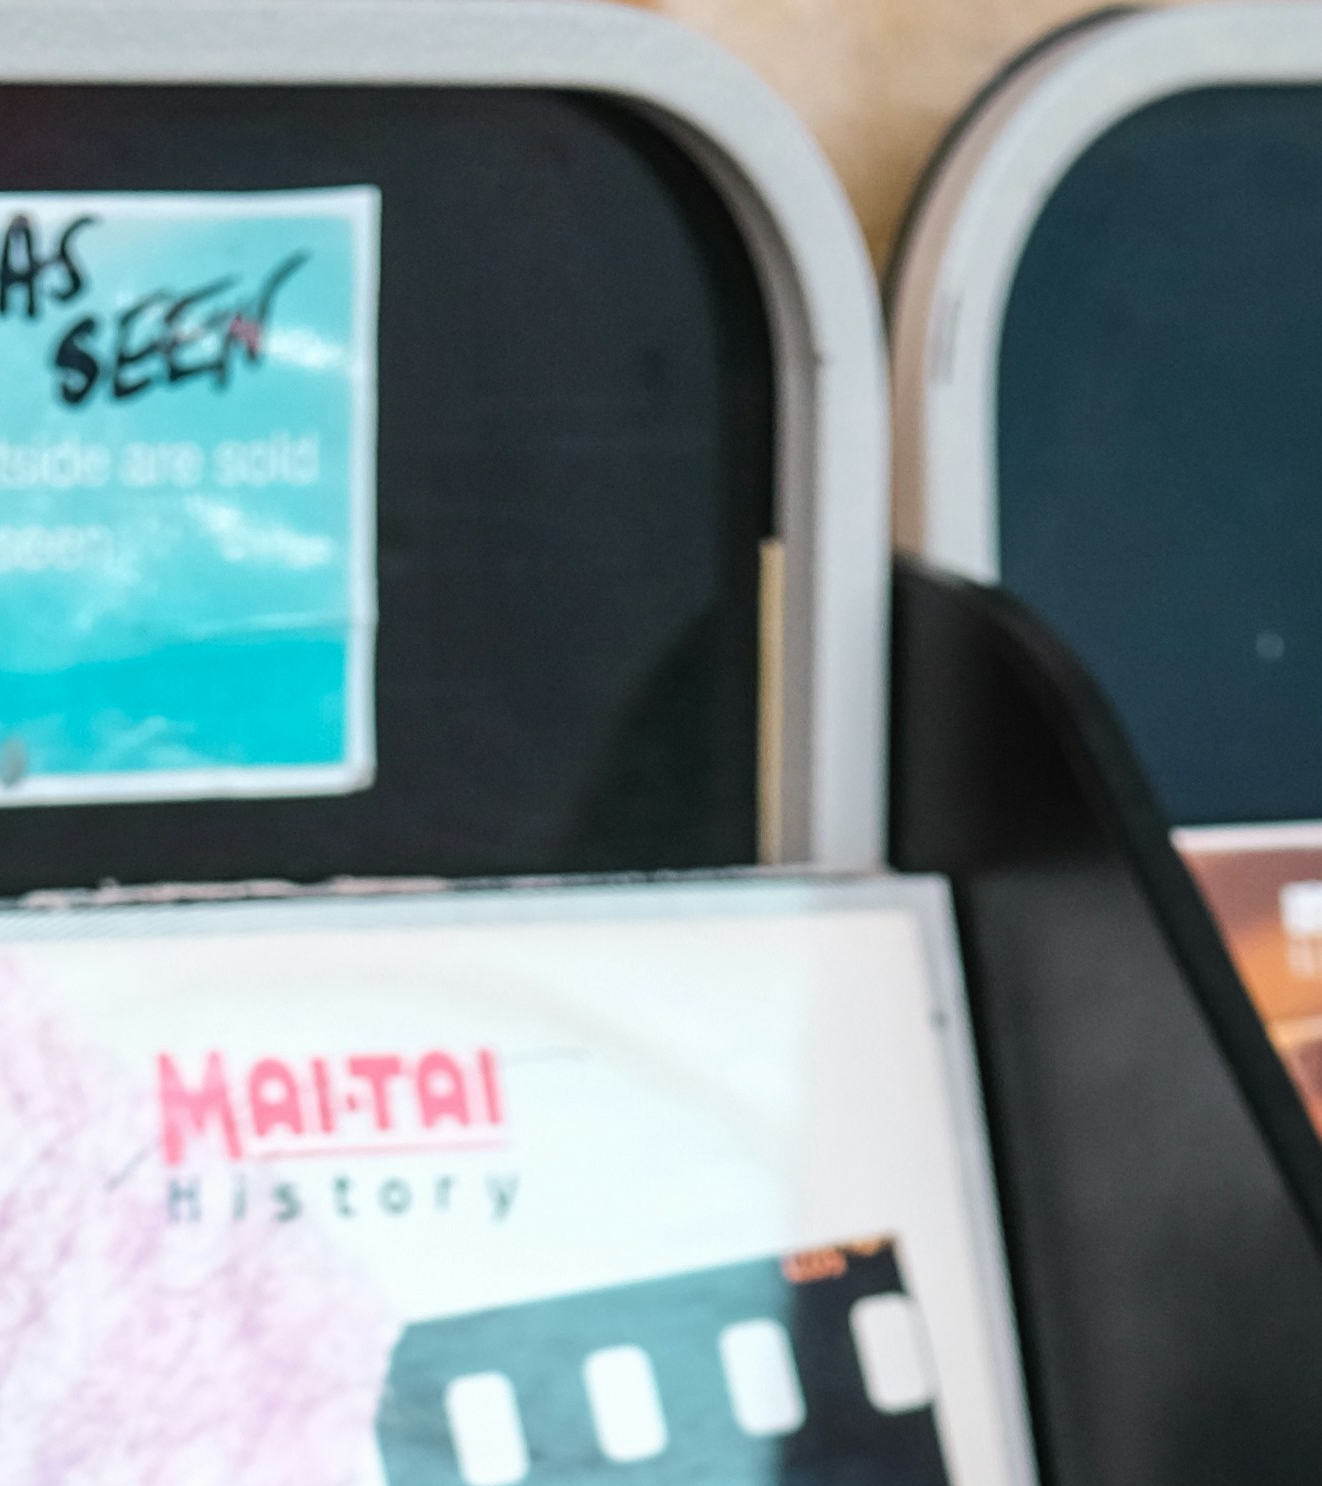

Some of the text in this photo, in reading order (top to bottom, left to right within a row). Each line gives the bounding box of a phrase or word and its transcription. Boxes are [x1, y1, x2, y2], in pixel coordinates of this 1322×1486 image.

[54, 250, 310, 405] SEEN
[119, 441, 205, 486] are
[212, 430, 320, 486] sold
[165, 1171, 522, 1224] History
